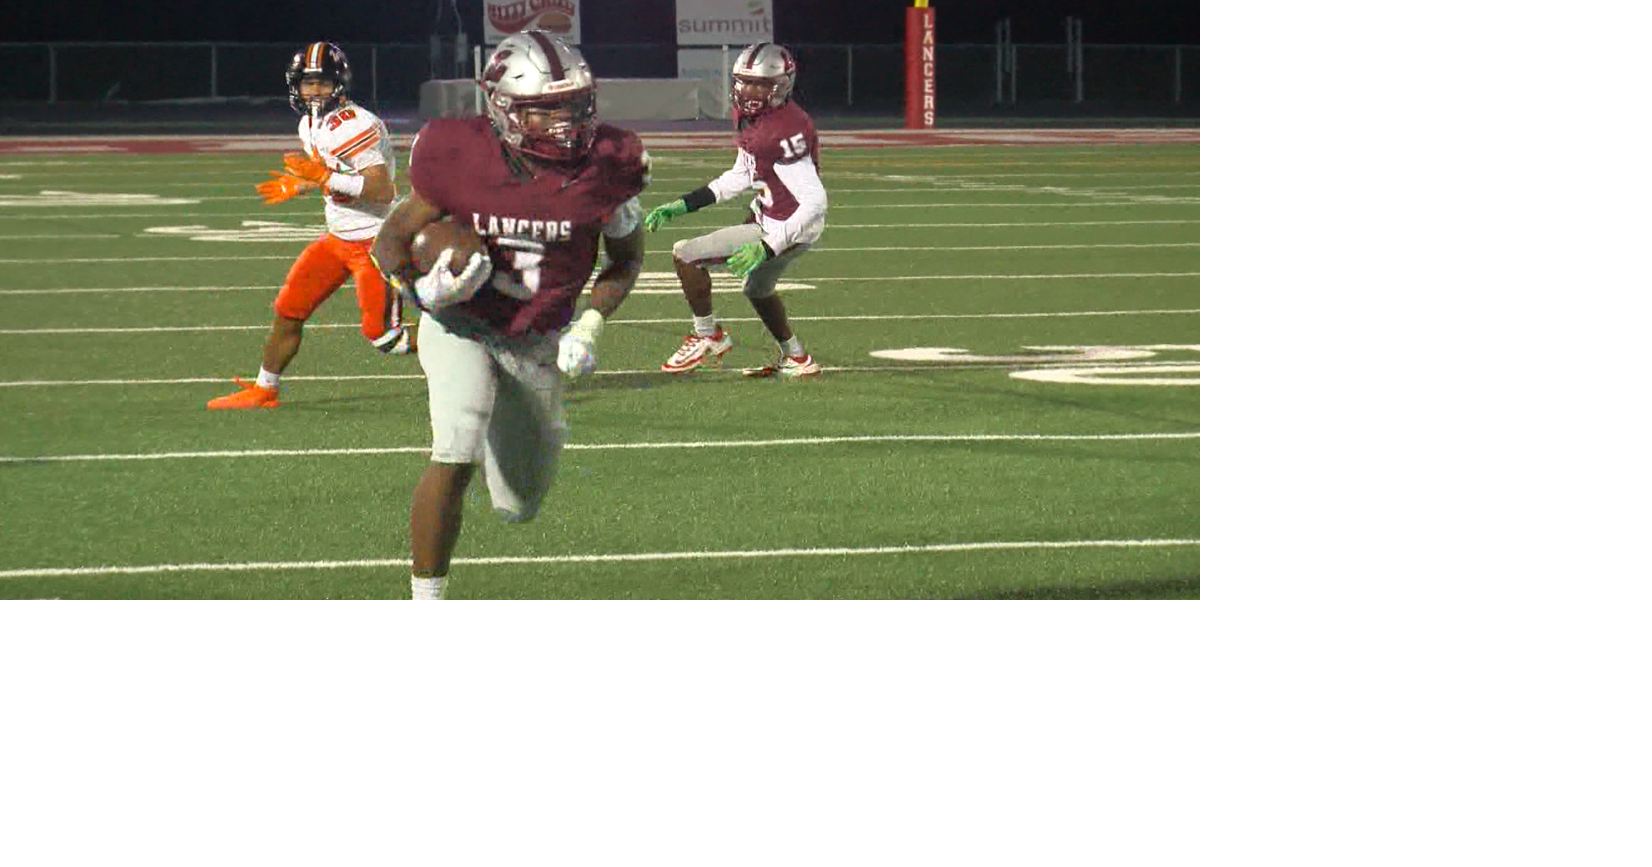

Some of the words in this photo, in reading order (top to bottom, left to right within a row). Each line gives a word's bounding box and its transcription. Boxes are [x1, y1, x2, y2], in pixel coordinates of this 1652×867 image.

[678, 17, 771, 33] summit
[922, 13, 935, 126] LANCERS
[780, 132, 807, 158] 15
[472, 212, 571, 241] LANCERS
